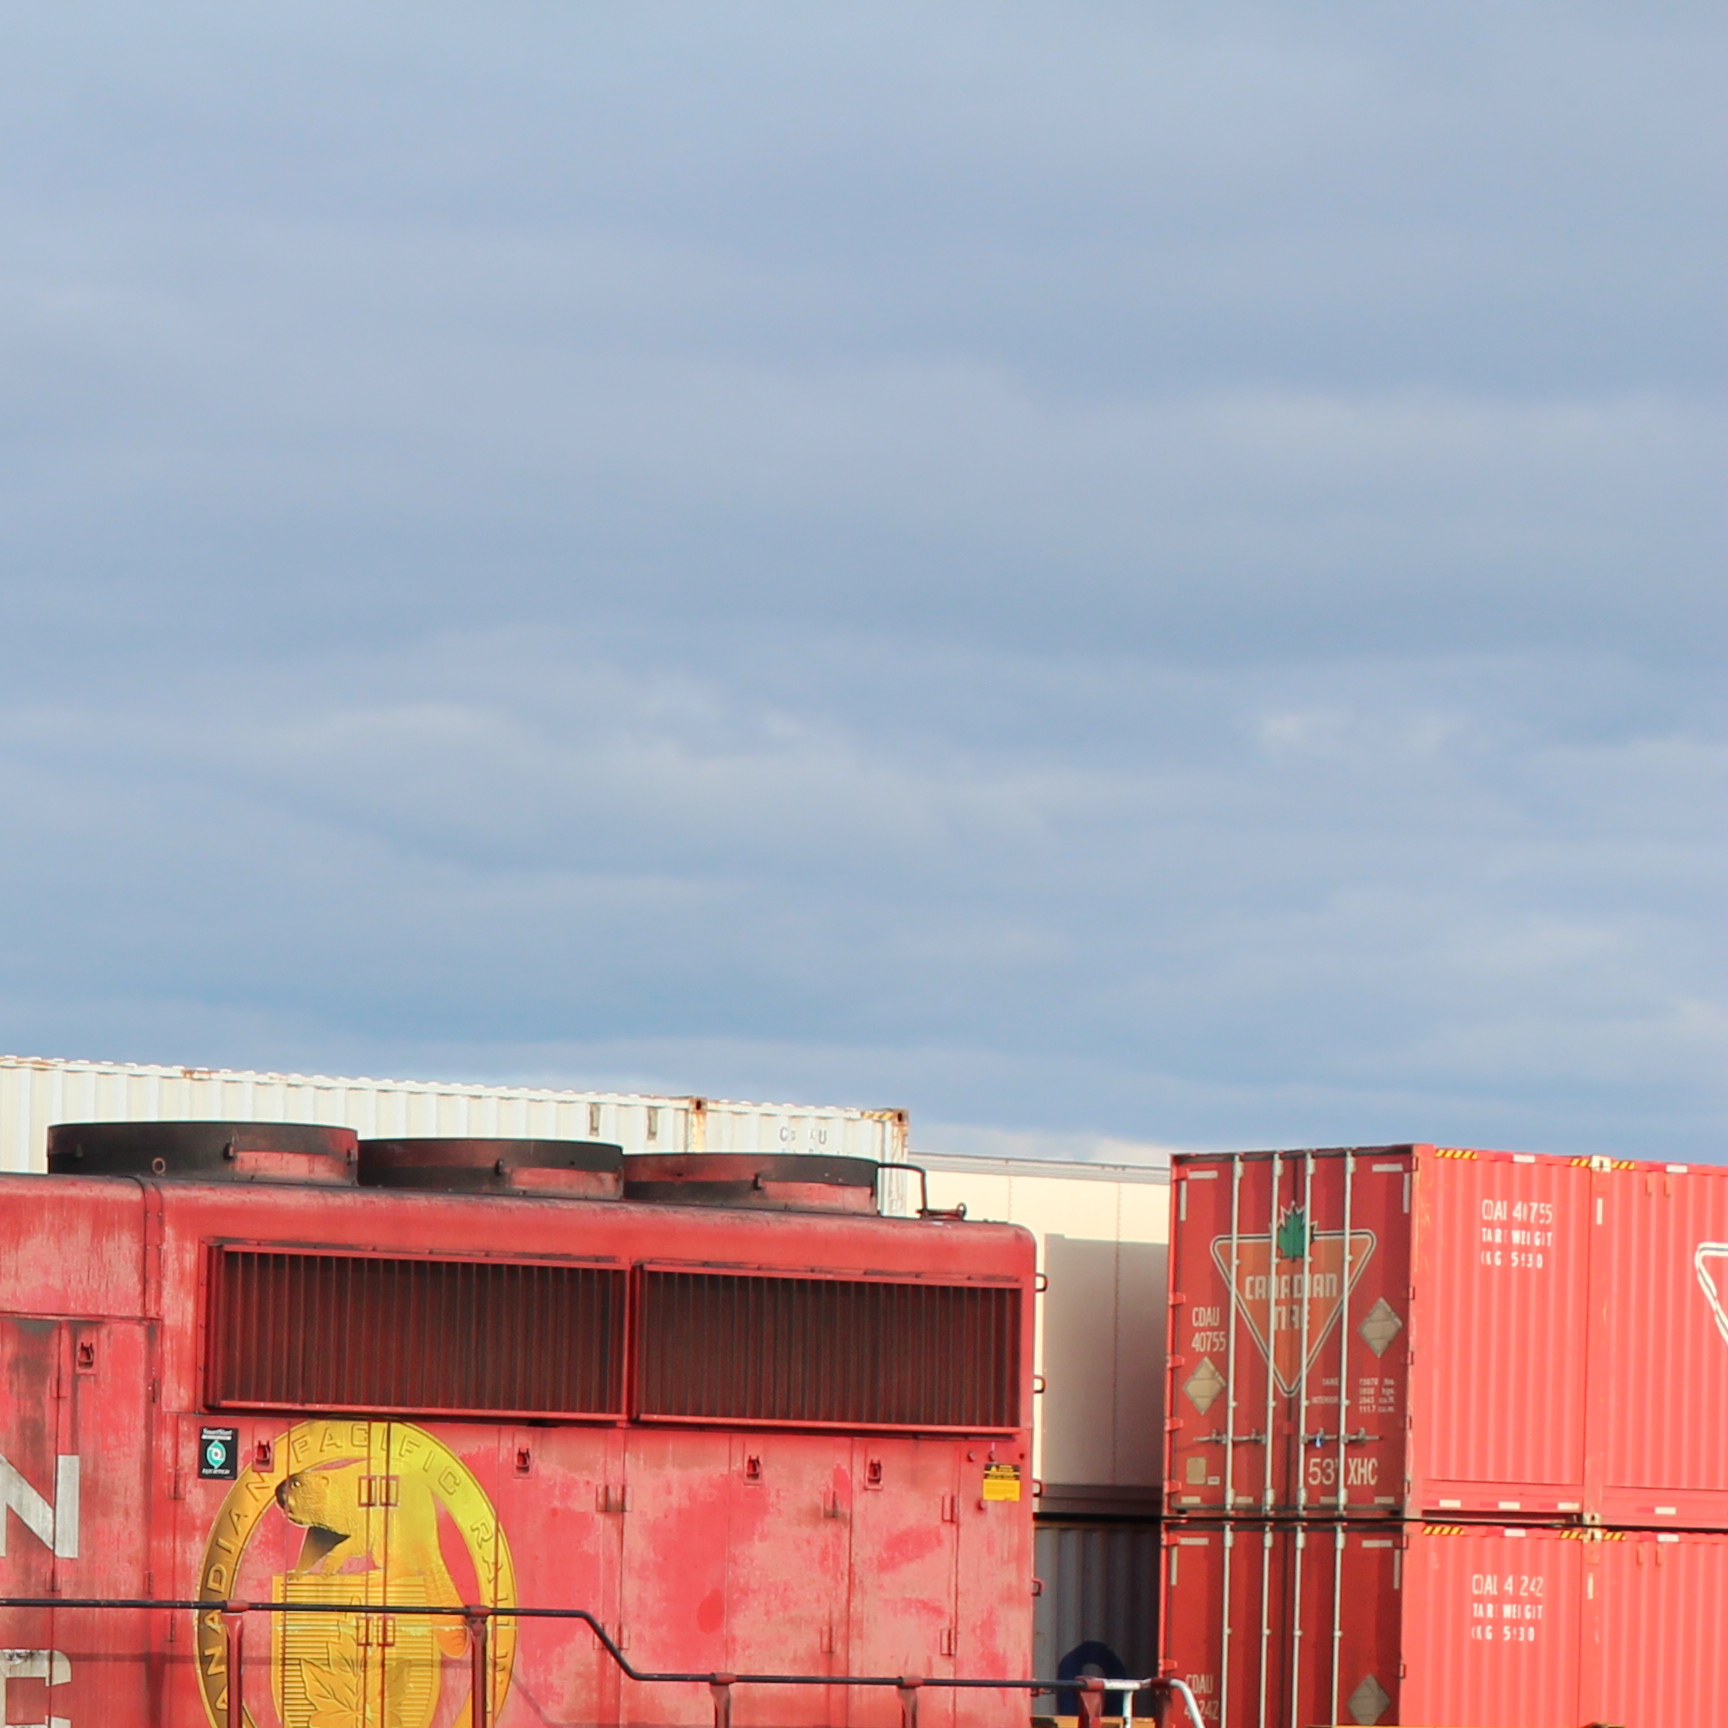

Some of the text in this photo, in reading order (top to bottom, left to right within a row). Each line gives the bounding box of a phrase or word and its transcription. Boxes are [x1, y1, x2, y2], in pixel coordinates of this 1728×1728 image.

[1192, 1306, 1220, 1327] CDAU
[1191, 1332, 1226, 1352] 40755
[291, 1423, 462, 1496] PACIFIC
[1347, 1458, 1378, 1486] XHC
[1504, 1575, 1544, 1597] 4242
